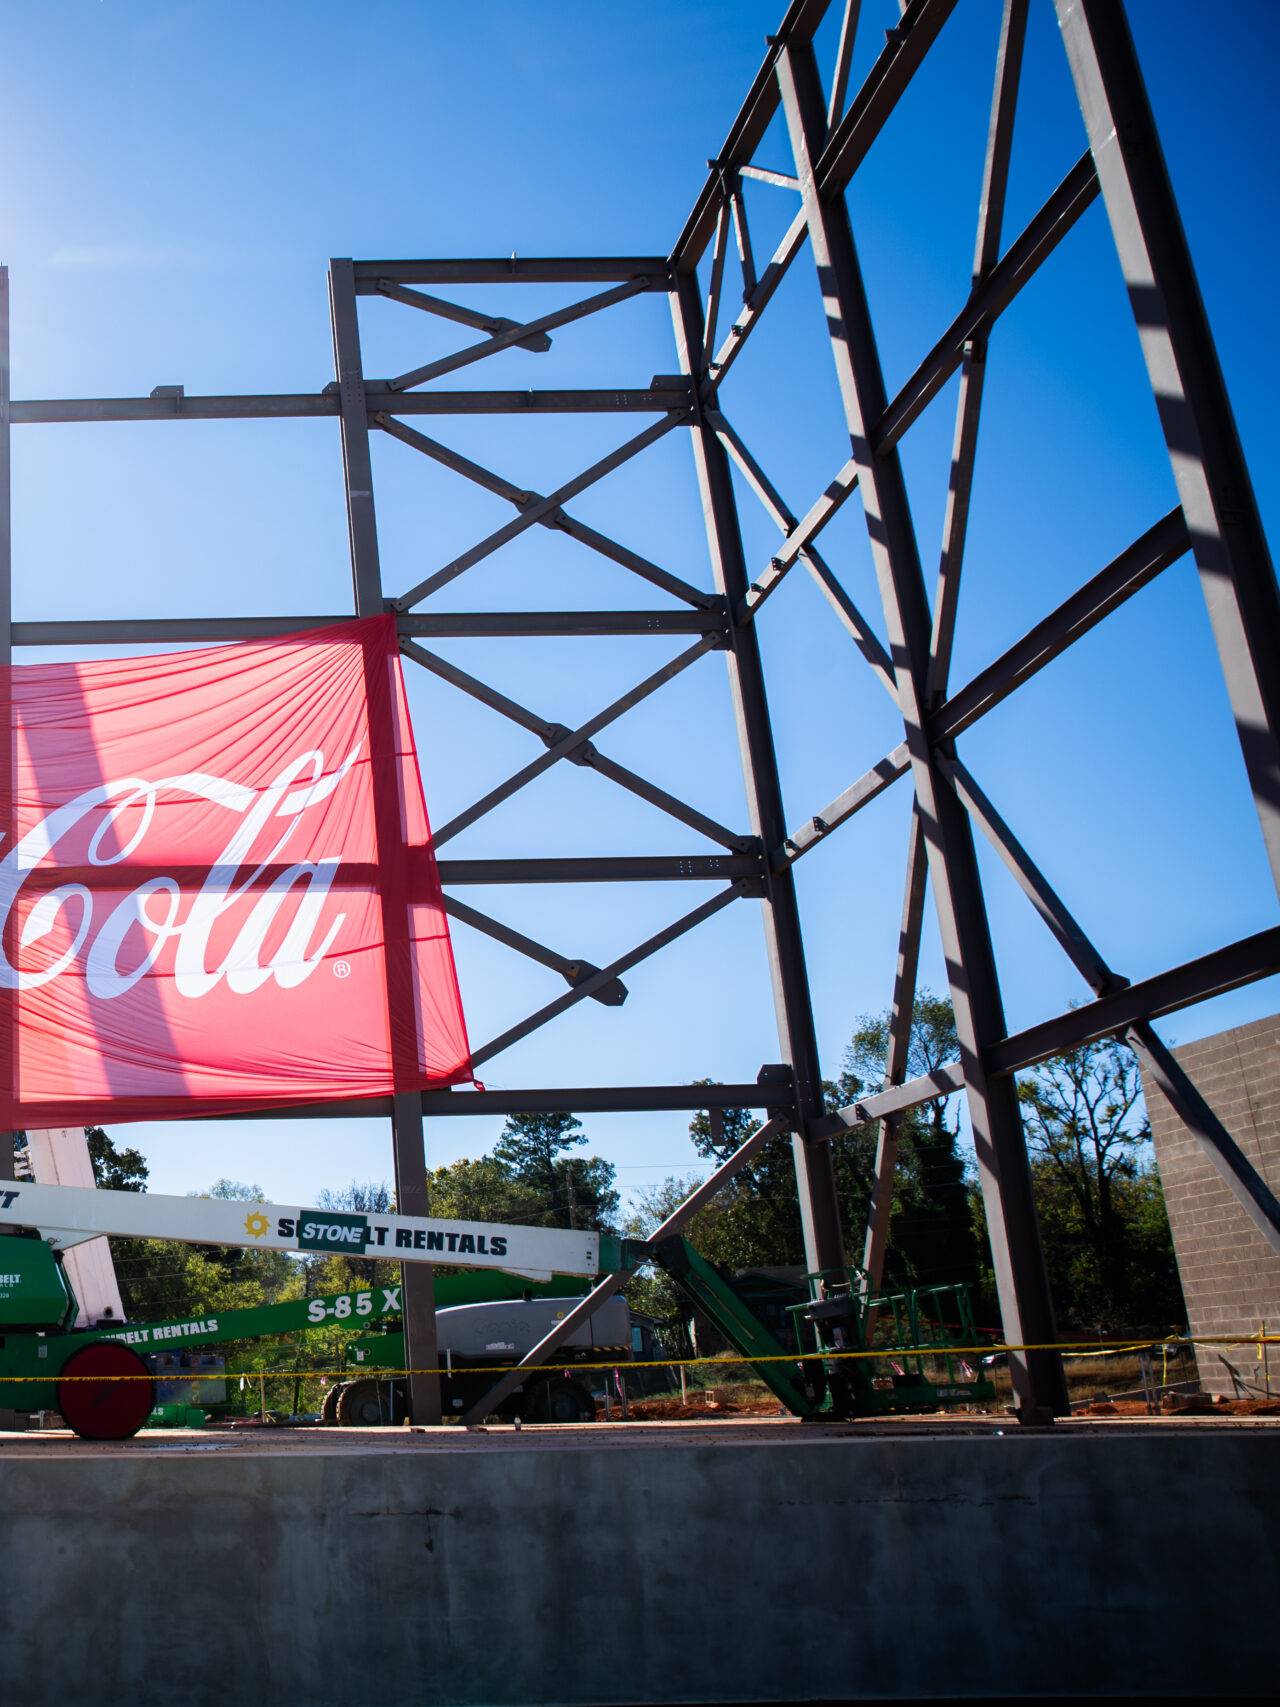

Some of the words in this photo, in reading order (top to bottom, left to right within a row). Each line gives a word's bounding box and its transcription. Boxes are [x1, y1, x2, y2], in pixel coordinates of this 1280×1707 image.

[302, 1222, 364, 1243] STONE
[395, 1228, 508, 1256] RENTALS
[152, 1319, 218, 1341] RENTALS
